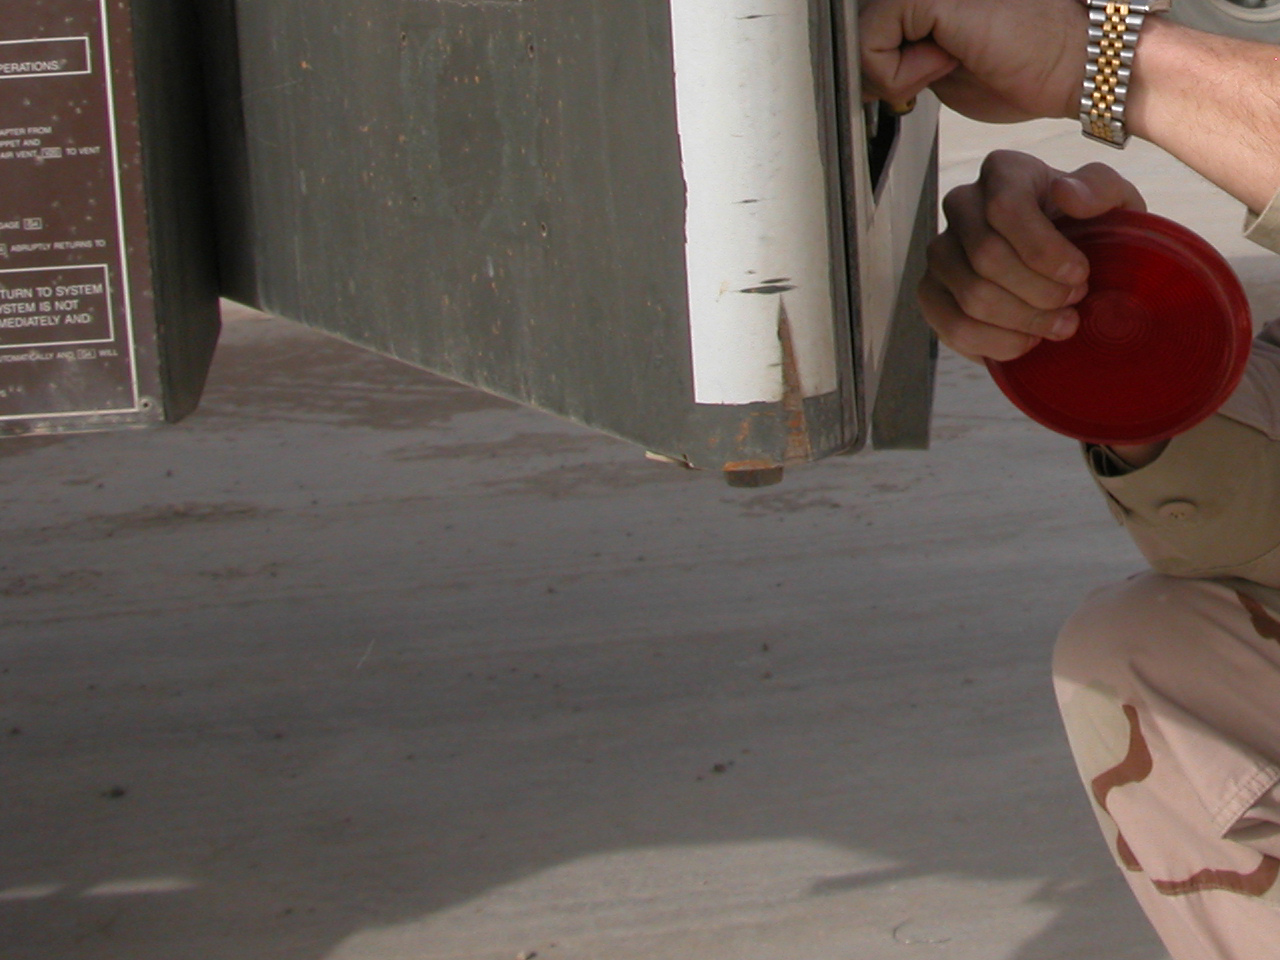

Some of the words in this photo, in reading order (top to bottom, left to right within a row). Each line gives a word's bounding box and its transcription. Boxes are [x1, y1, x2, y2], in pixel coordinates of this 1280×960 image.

[35, 286, 53, 298] TO
[55, 283, 104, 297] SYSTEM
[39, 300, 52, 312] IS
[54, 299, 79, 312] NOT
[64, 312, 92, 325] AND
